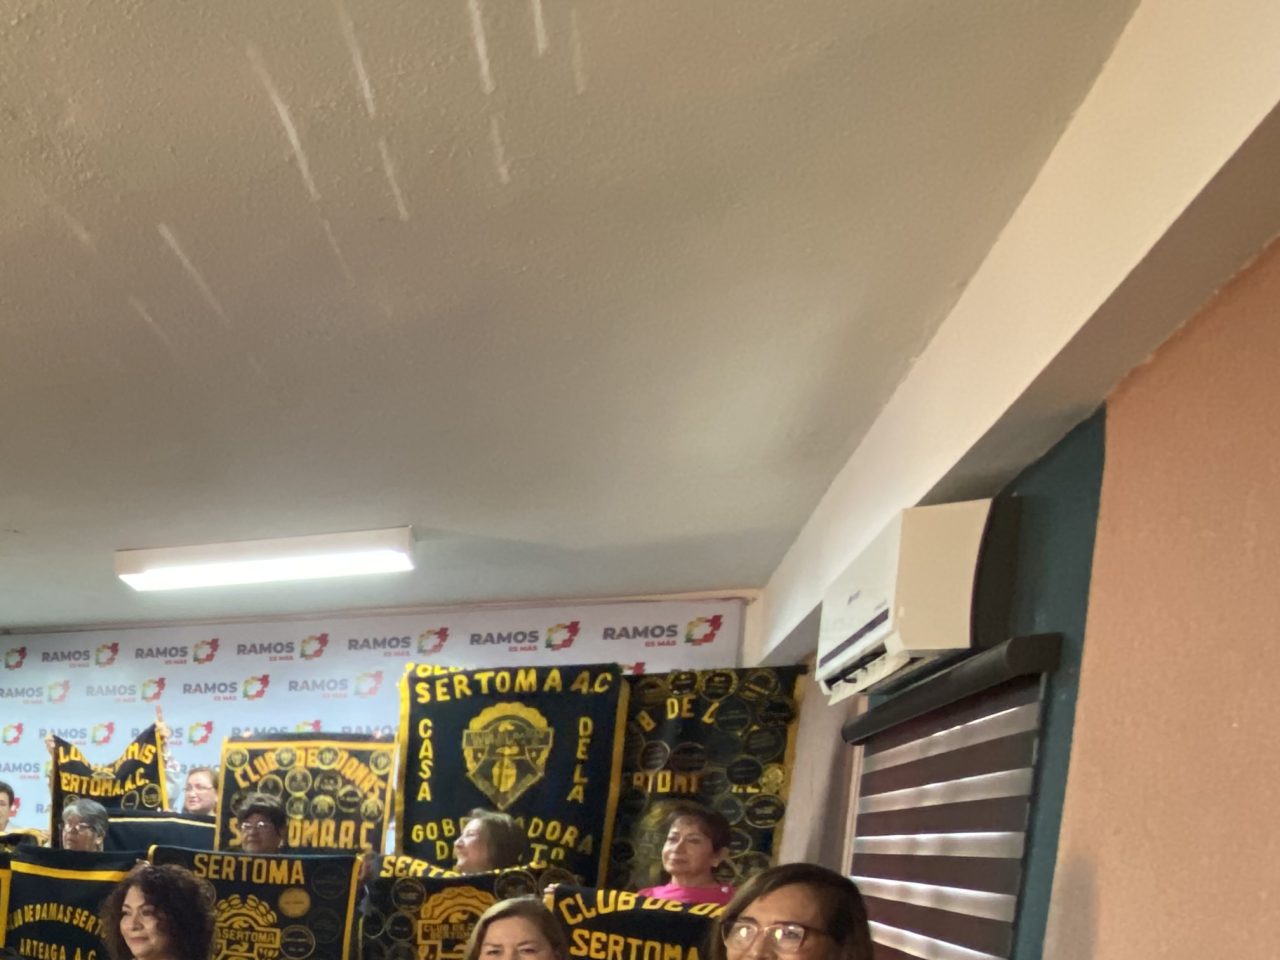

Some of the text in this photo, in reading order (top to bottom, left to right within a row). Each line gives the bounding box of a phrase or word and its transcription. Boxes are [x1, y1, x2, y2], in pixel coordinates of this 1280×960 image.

[470, 629, 539, 646] RAMOS
[603, 624, 678, 641] RAMOS
[236, 642, 295, 655] RAMOS
[348, 636, 411, 651] RAMOS
[41, 650, 90, 662] RAMOS
[135, 646, 188, 659] RAMOS
[86, 685, 137, 696] RAMOS
[183, 682, 238, 695] RAMOS
[288, 679, 349, 692] RAMOS
[415, 668, 562, 703] SERTOMA
[417, 719, 433, 802] CASA
[193, 854, 305, 885] SERTOMA
[558, 889, 638, 925] CLUB
[222, 930, 276, 944] SERTOMA
